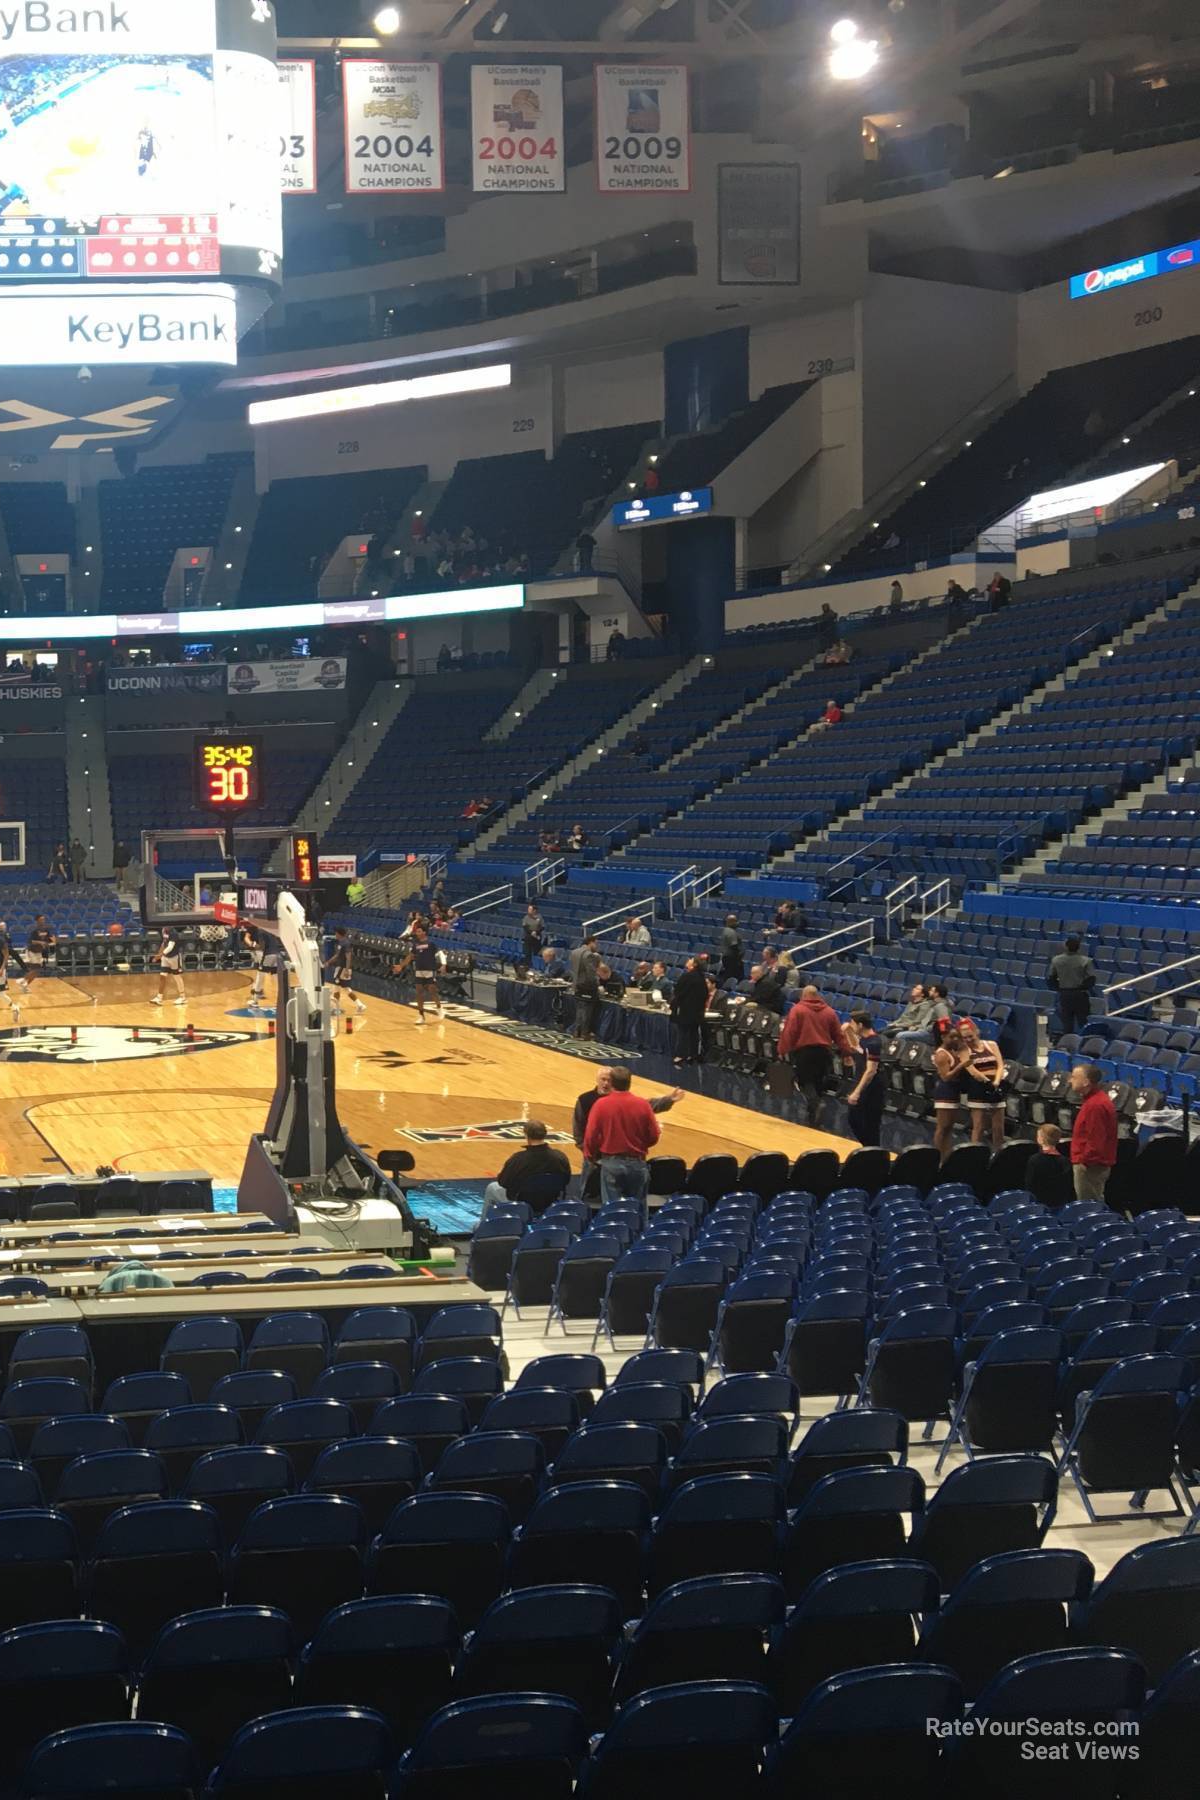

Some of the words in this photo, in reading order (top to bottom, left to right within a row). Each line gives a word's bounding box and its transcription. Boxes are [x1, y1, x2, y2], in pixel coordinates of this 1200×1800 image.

[389, 64, 431, 73] Women's
[368, 75, 417, 84] Basketball
[354, 135, 434, 158] 2004
[479, 137, 558, 160] 2004
[604, 137, 682, 160] 2009
[363, 163, 427, 173] NATIONAL
[487, 165, 550, 175] NATIONAL
[613, 165, 674, 174] NATIONAL
[358, 177, 432, 187] CHAMPIONS
[482, 179, 556, 189] CHAMPIONS
[608, 178, 680, 188] CHAMPIONS
[1133, 306, 1163, 328] 200
[68, 313, 229, 350] KeyBank
[511, 418, 536, 433] 229
[602, 617, 619, 627] 124
[108, 676, 161, 690] UCONN
[0, 687, 63, 700] HUSKIES
[203, 745, 253, 766] 35:42
[210, 767, 249, 801] 30
[319, 861, 354, 872] ESPN
[244, 888, 267, 910] UCONN
